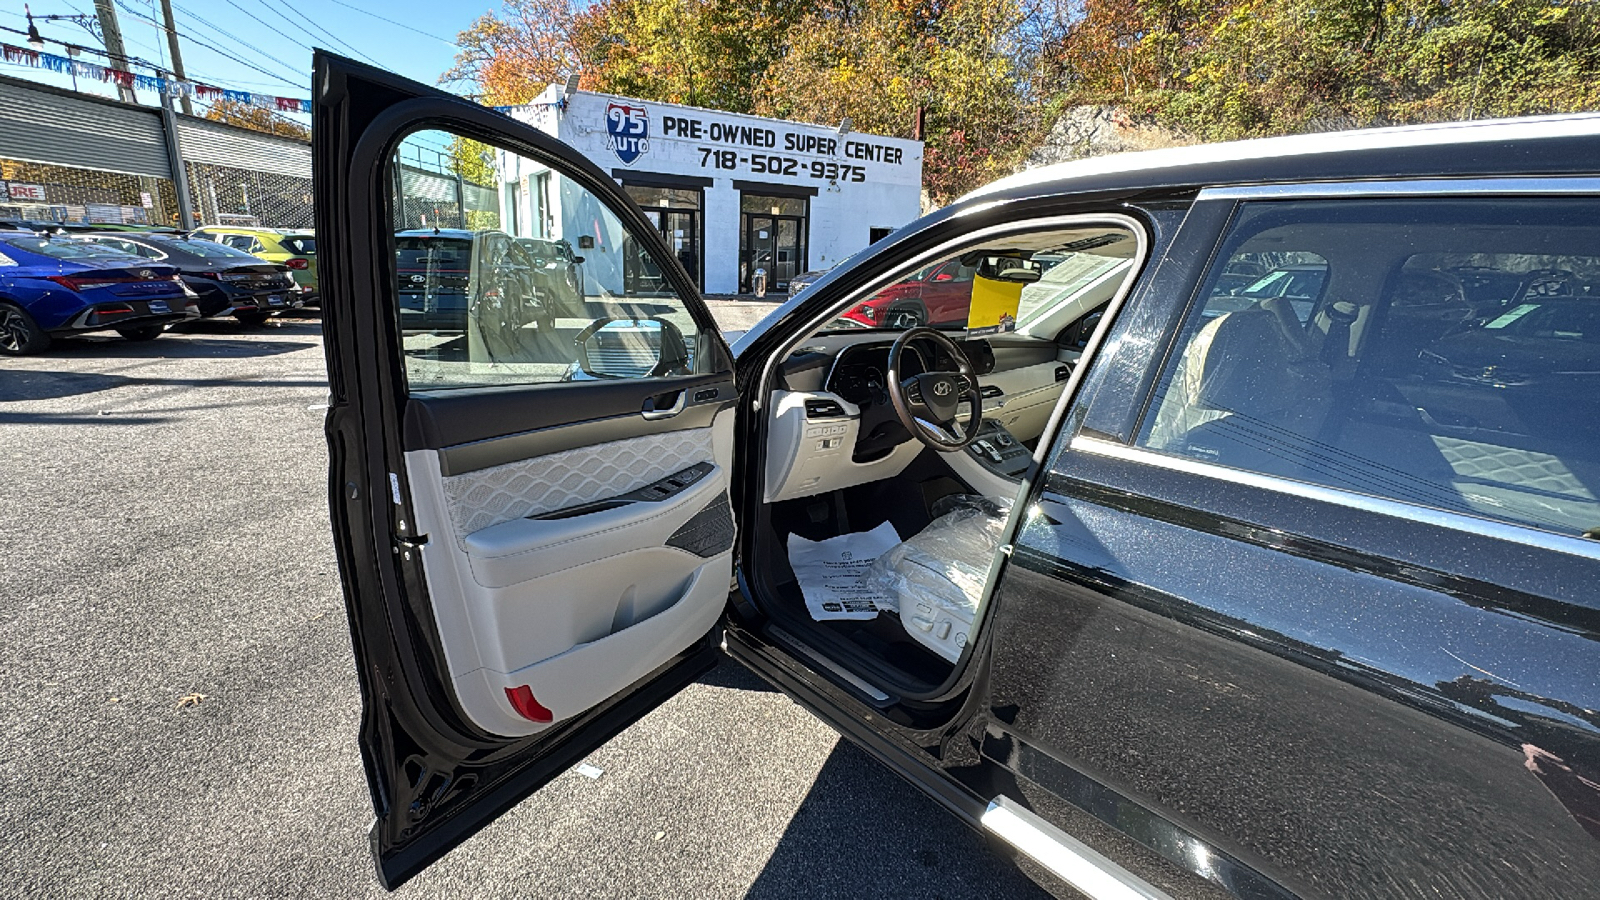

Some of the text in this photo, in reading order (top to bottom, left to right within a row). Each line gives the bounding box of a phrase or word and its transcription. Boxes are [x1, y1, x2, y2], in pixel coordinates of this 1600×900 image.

[609, 106, 645, 134] 95
[606, 135, 649, 154] AUTO
[663, 116, 903, 165] PRE-OWNED SUPER CENTER
[697, 147, 866, 183] 718-502-9375
